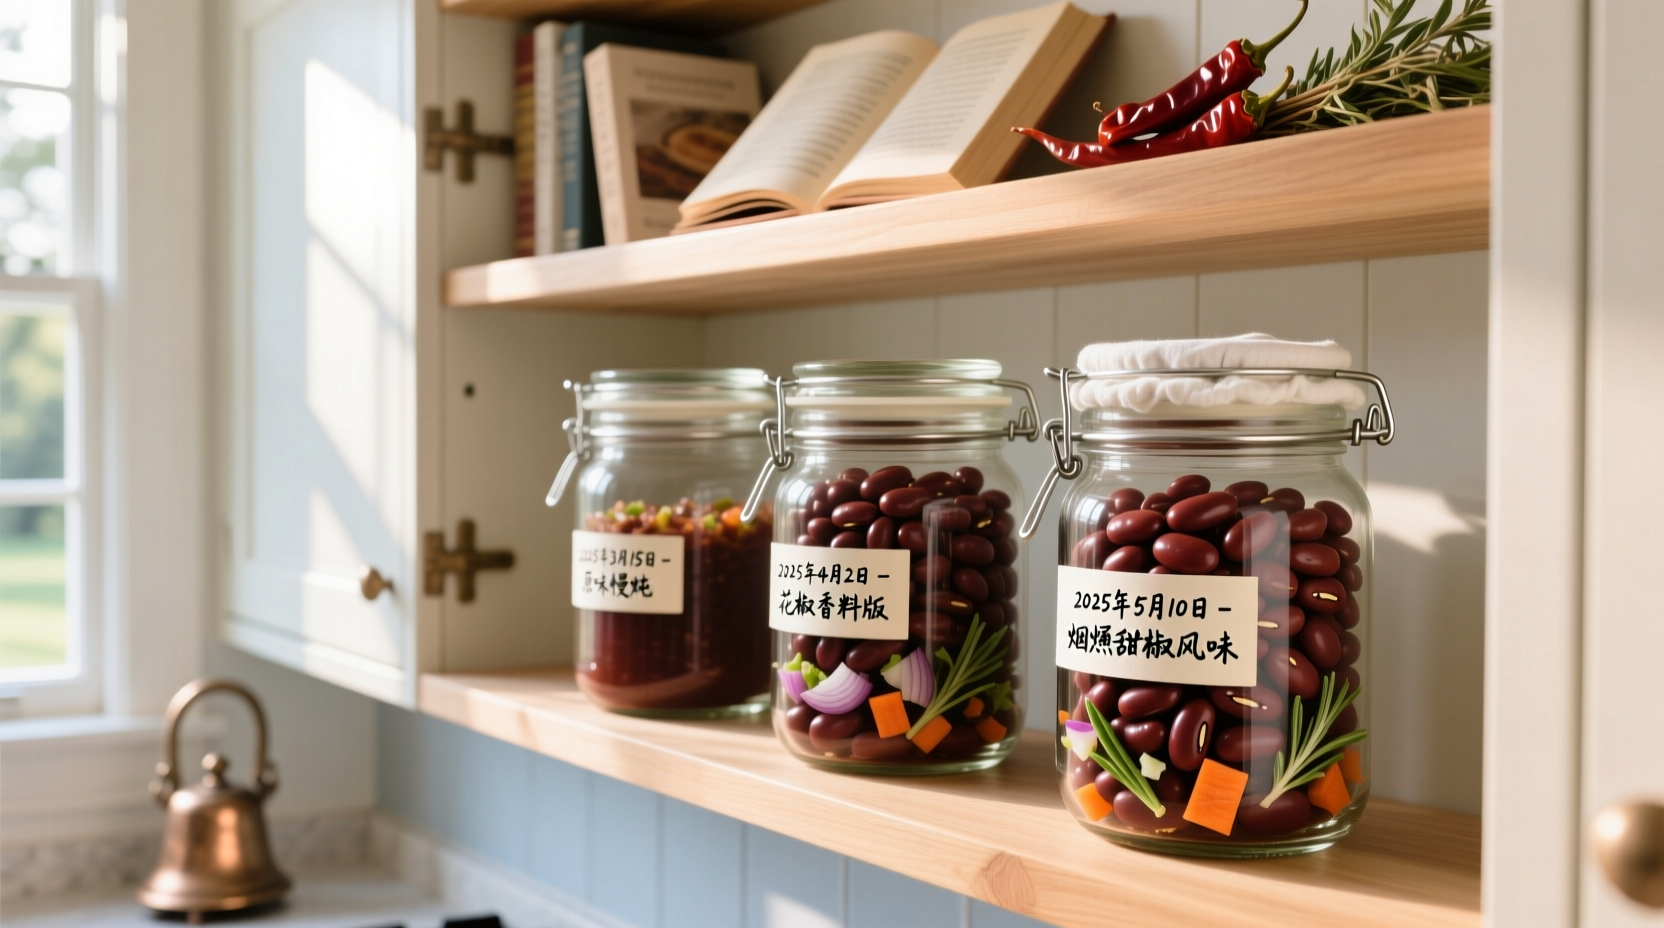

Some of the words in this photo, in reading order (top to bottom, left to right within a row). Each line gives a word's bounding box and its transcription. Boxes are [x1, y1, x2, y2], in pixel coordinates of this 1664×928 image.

[579, 547, 655, 567] 25年3月15日
[778, 561, 868, 585] 2025年4月2日
[778, 589, 889, 622] 花椒香料版
[1074, 589, 1207, 620] 2025年5月10日
